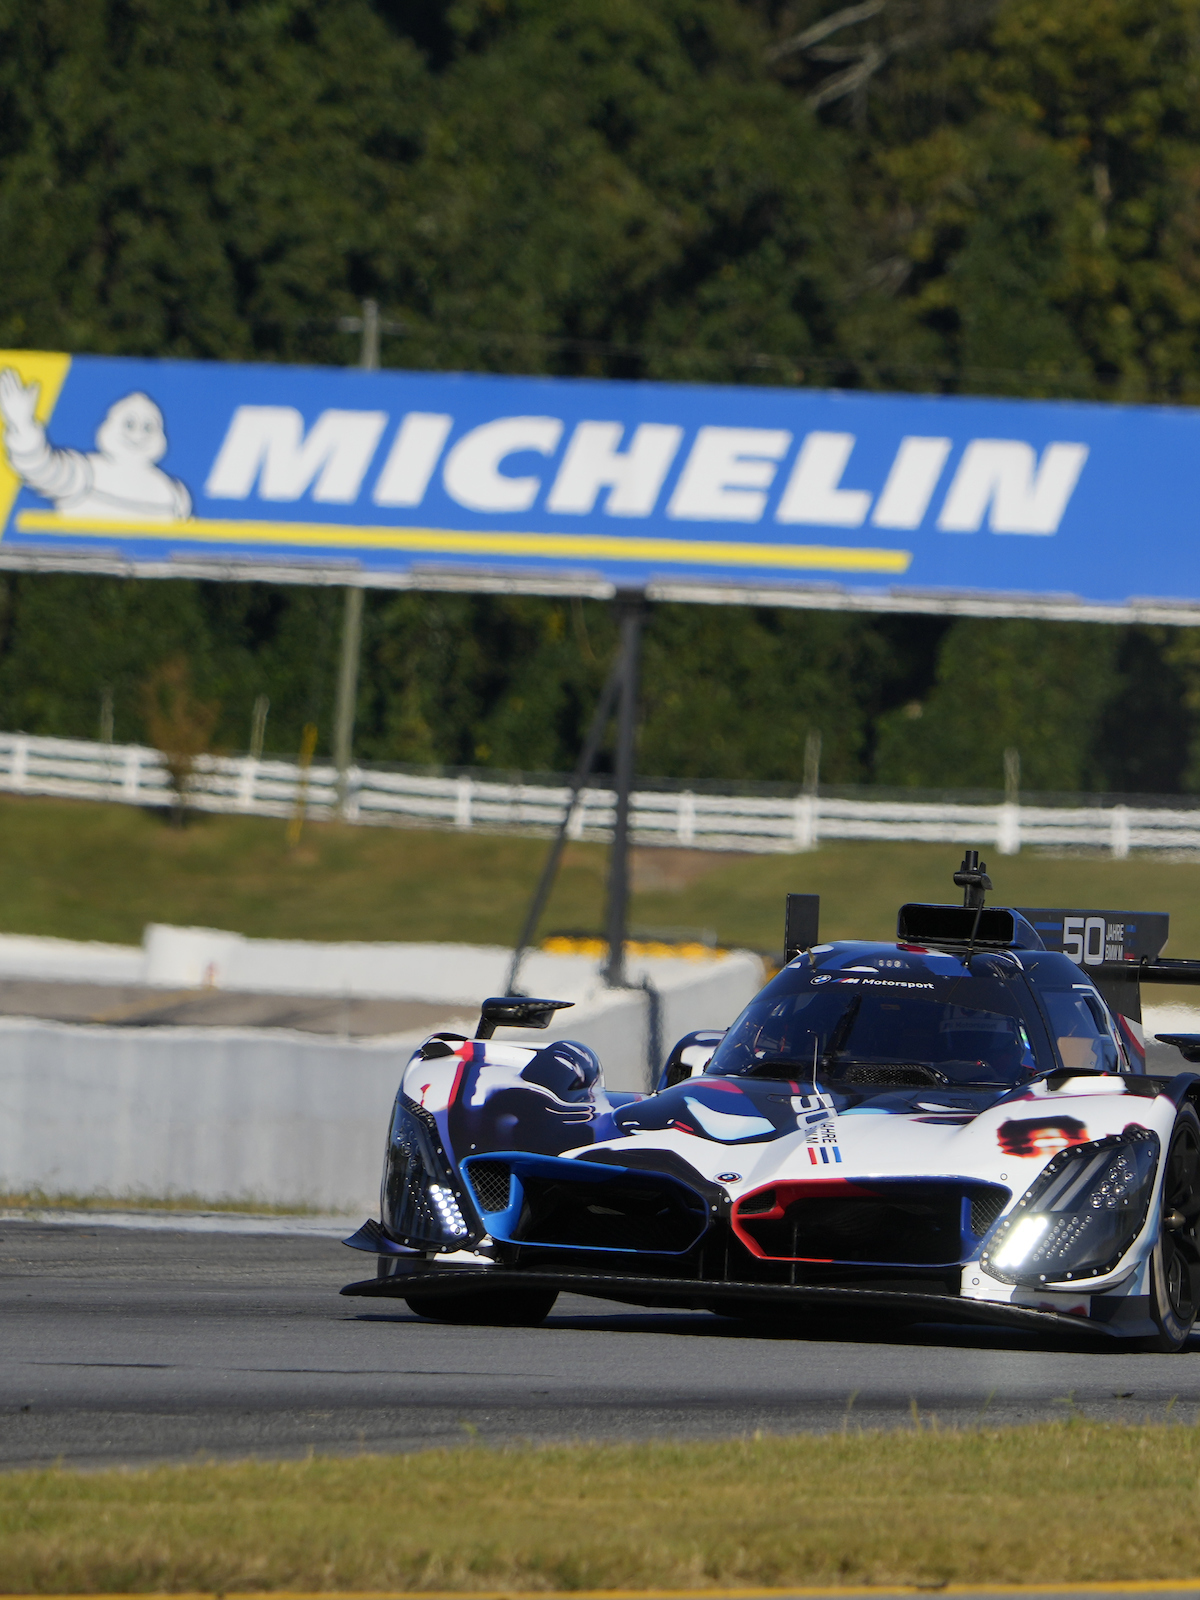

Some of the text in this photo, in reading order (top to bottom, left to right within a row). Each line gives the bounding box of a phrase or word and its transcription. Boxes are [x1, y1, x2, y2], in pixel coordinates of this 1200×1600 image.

[205, 404, 1088, 535] MICHELIN
[1063, 917, 1105, 966] 50
[1106, 924, 1124, 941] JAHRE
[862, 979, 935, 990] Motorsport
[791, 1093, 838, 1130] 50
